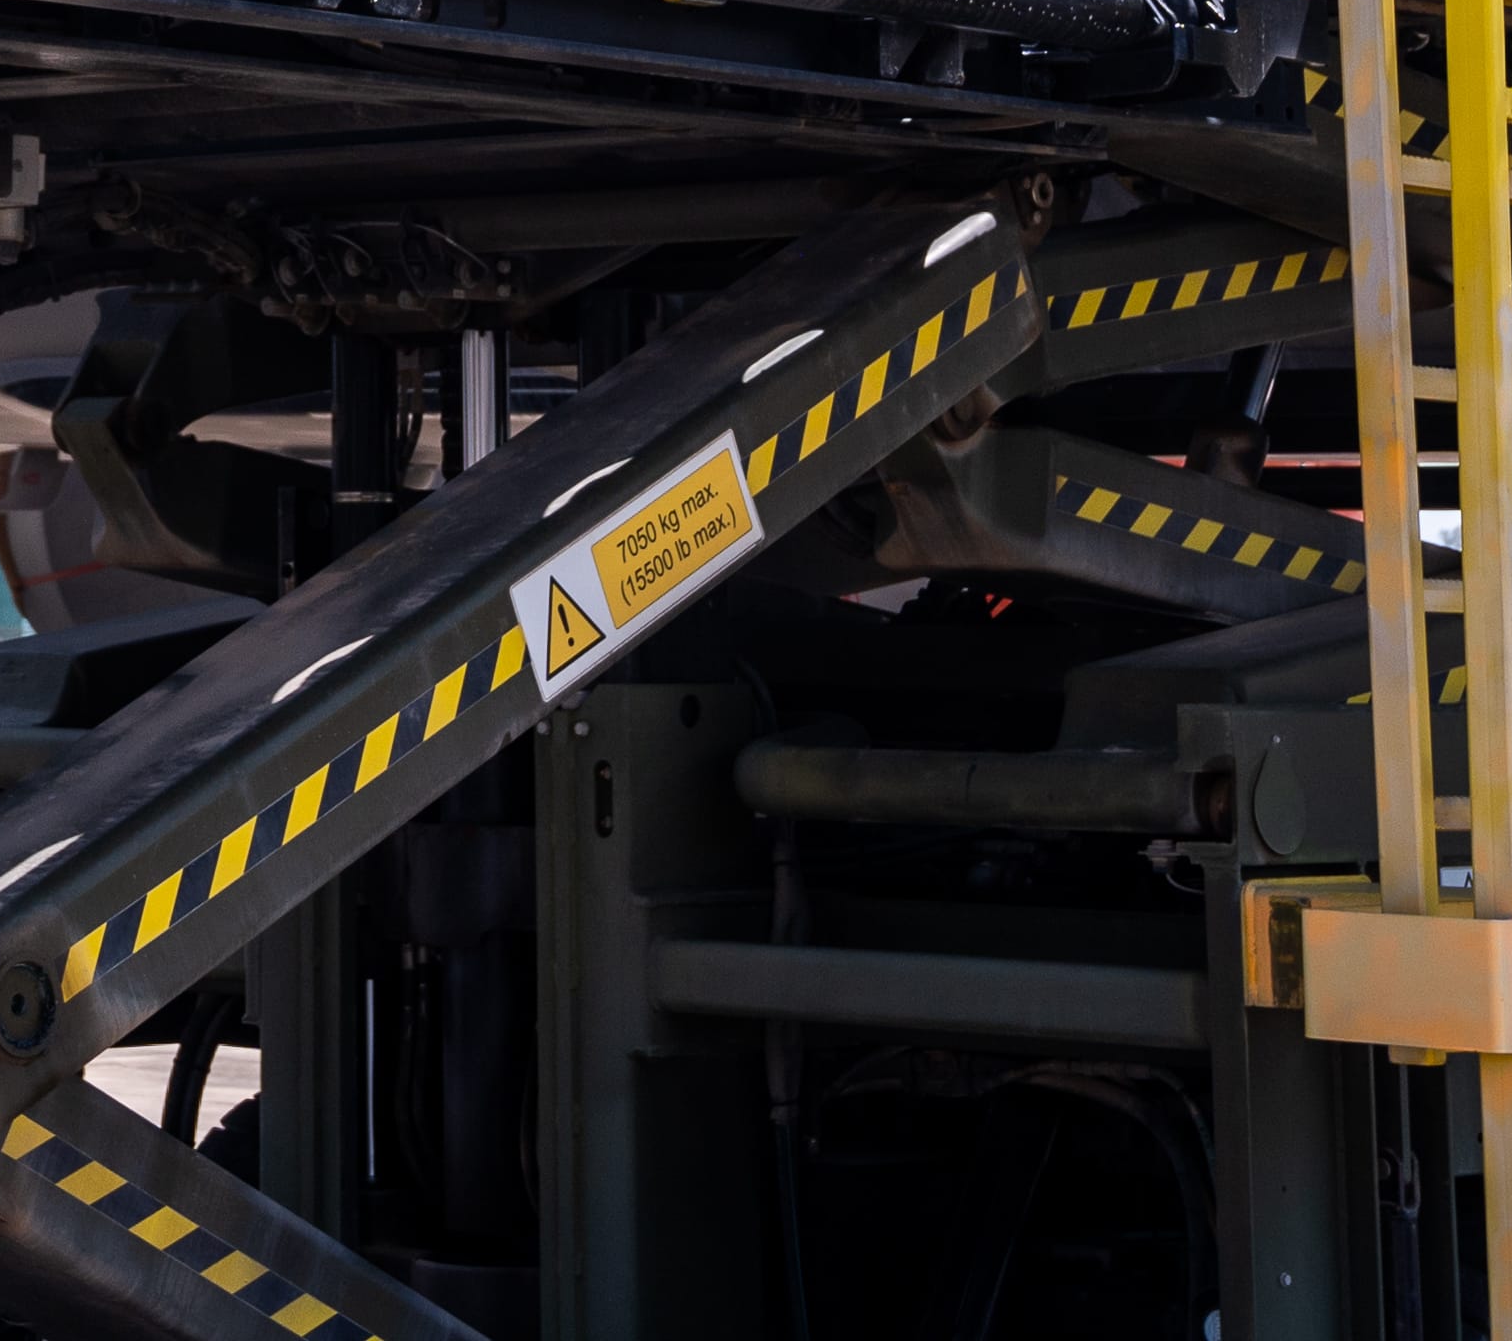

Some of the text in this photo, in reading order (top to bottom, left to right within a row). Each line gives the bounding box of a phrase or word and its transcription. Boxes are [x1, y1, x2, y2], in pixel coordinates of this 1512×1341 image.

[616, 483, 719, 564] 7050 kg max.
[620, 502, 736, 606] (15500 lb max.)
